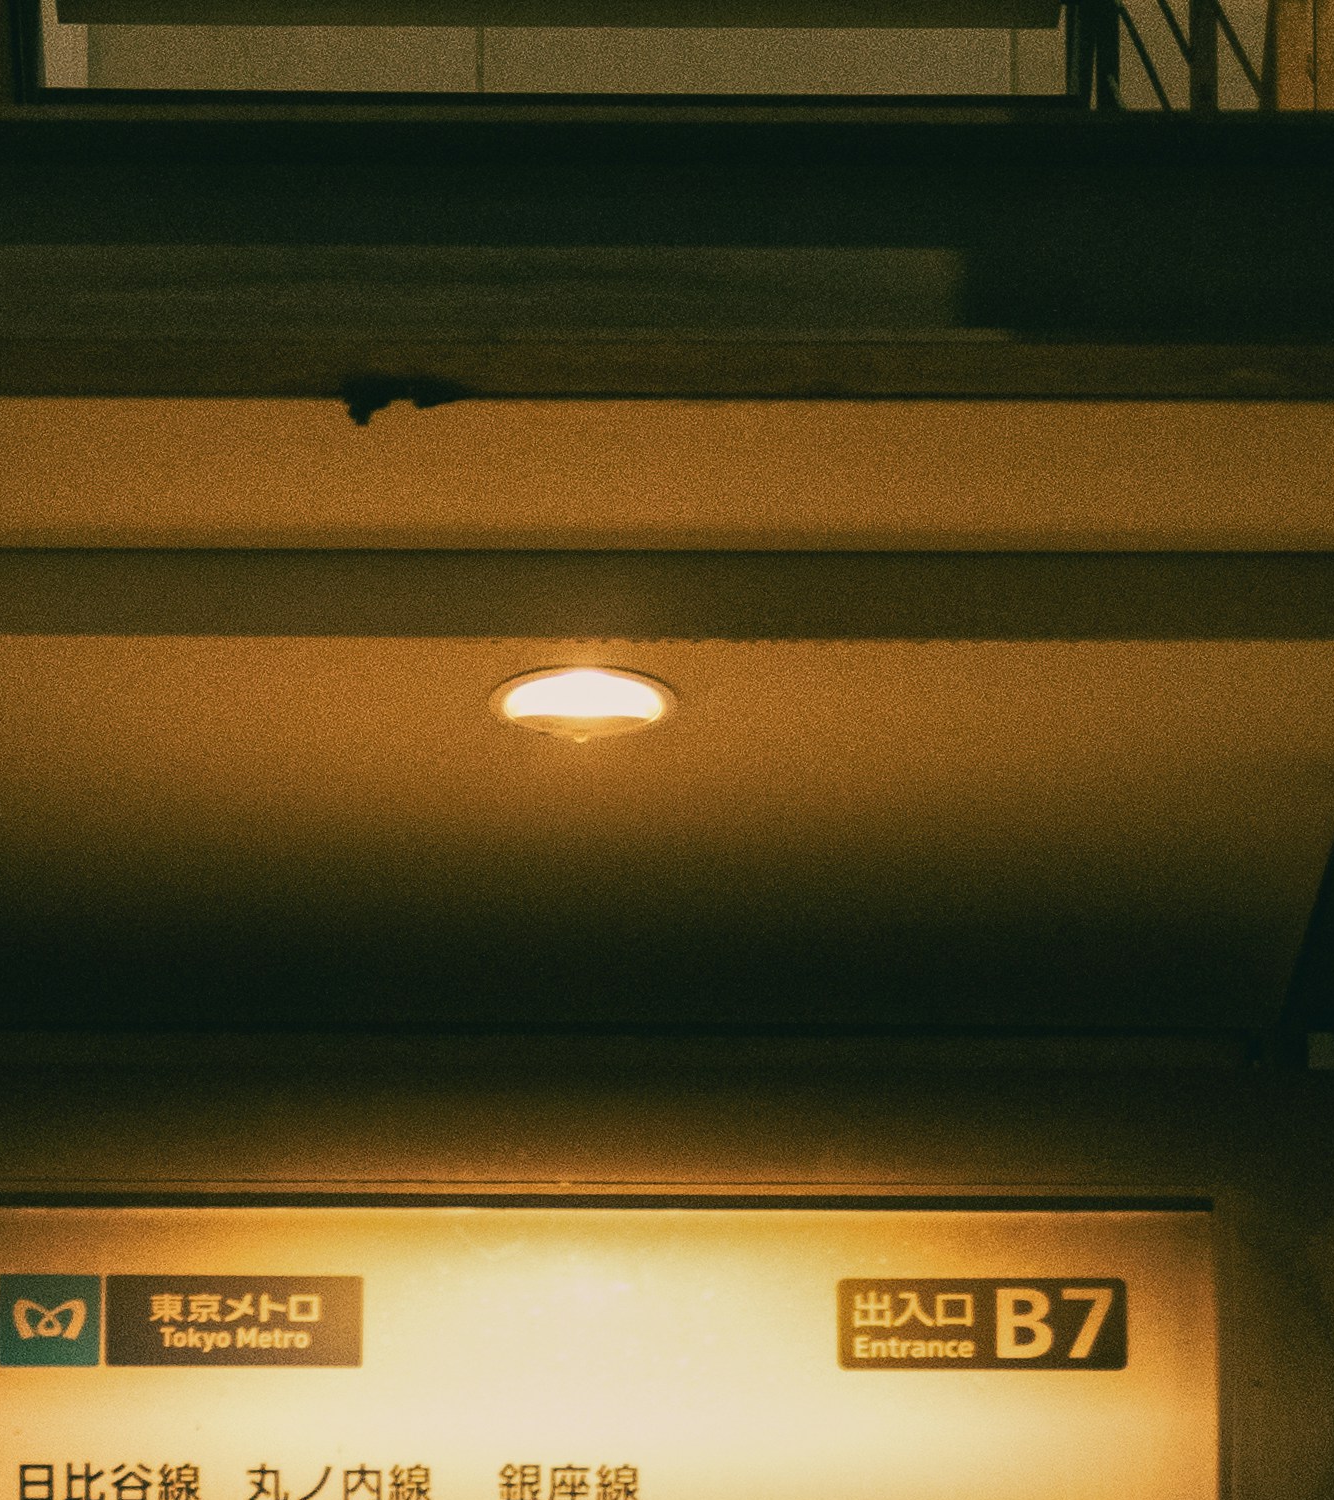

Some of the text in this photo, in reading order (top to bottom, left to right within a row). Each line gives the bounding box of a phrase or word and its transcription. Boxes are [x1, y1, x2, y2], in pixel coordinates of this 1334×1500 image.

[149, 1293, 322, 1323] 東京メトロ
[852, 1291, 974, 1328] 出入口
[995, 1287, 1113, 1359] B7
[160, 1326, 311, 1352] Tokyo Metro
[852, 1334, 974, 1358] Entrance
